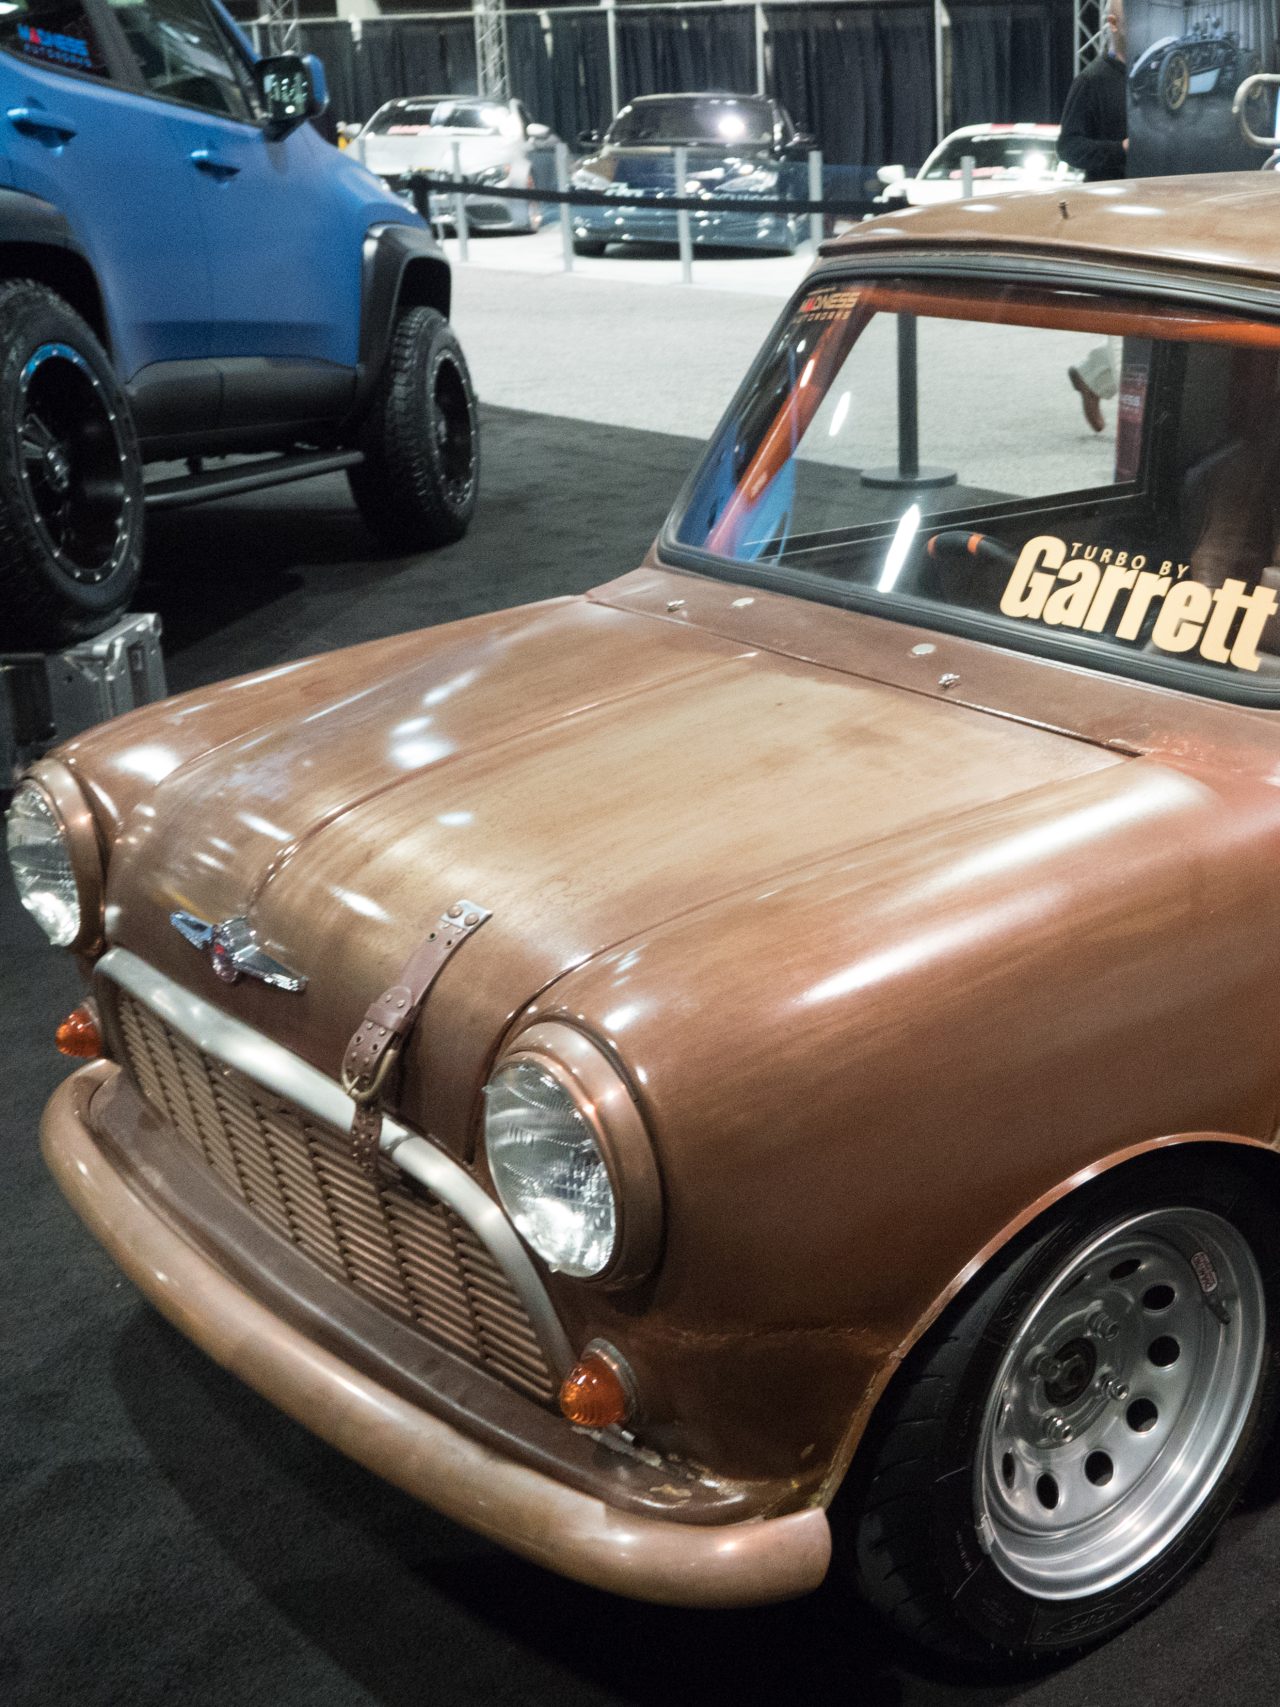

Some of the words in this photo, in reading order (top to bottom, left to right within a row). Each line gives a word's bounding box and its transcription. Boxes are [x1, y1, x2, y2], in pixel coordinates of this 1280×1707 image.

[999, 535, 1279, 672] Garrett
[1070, 542, 1147, 570] TURBO
[1158, 560, 1191, 579] BY
